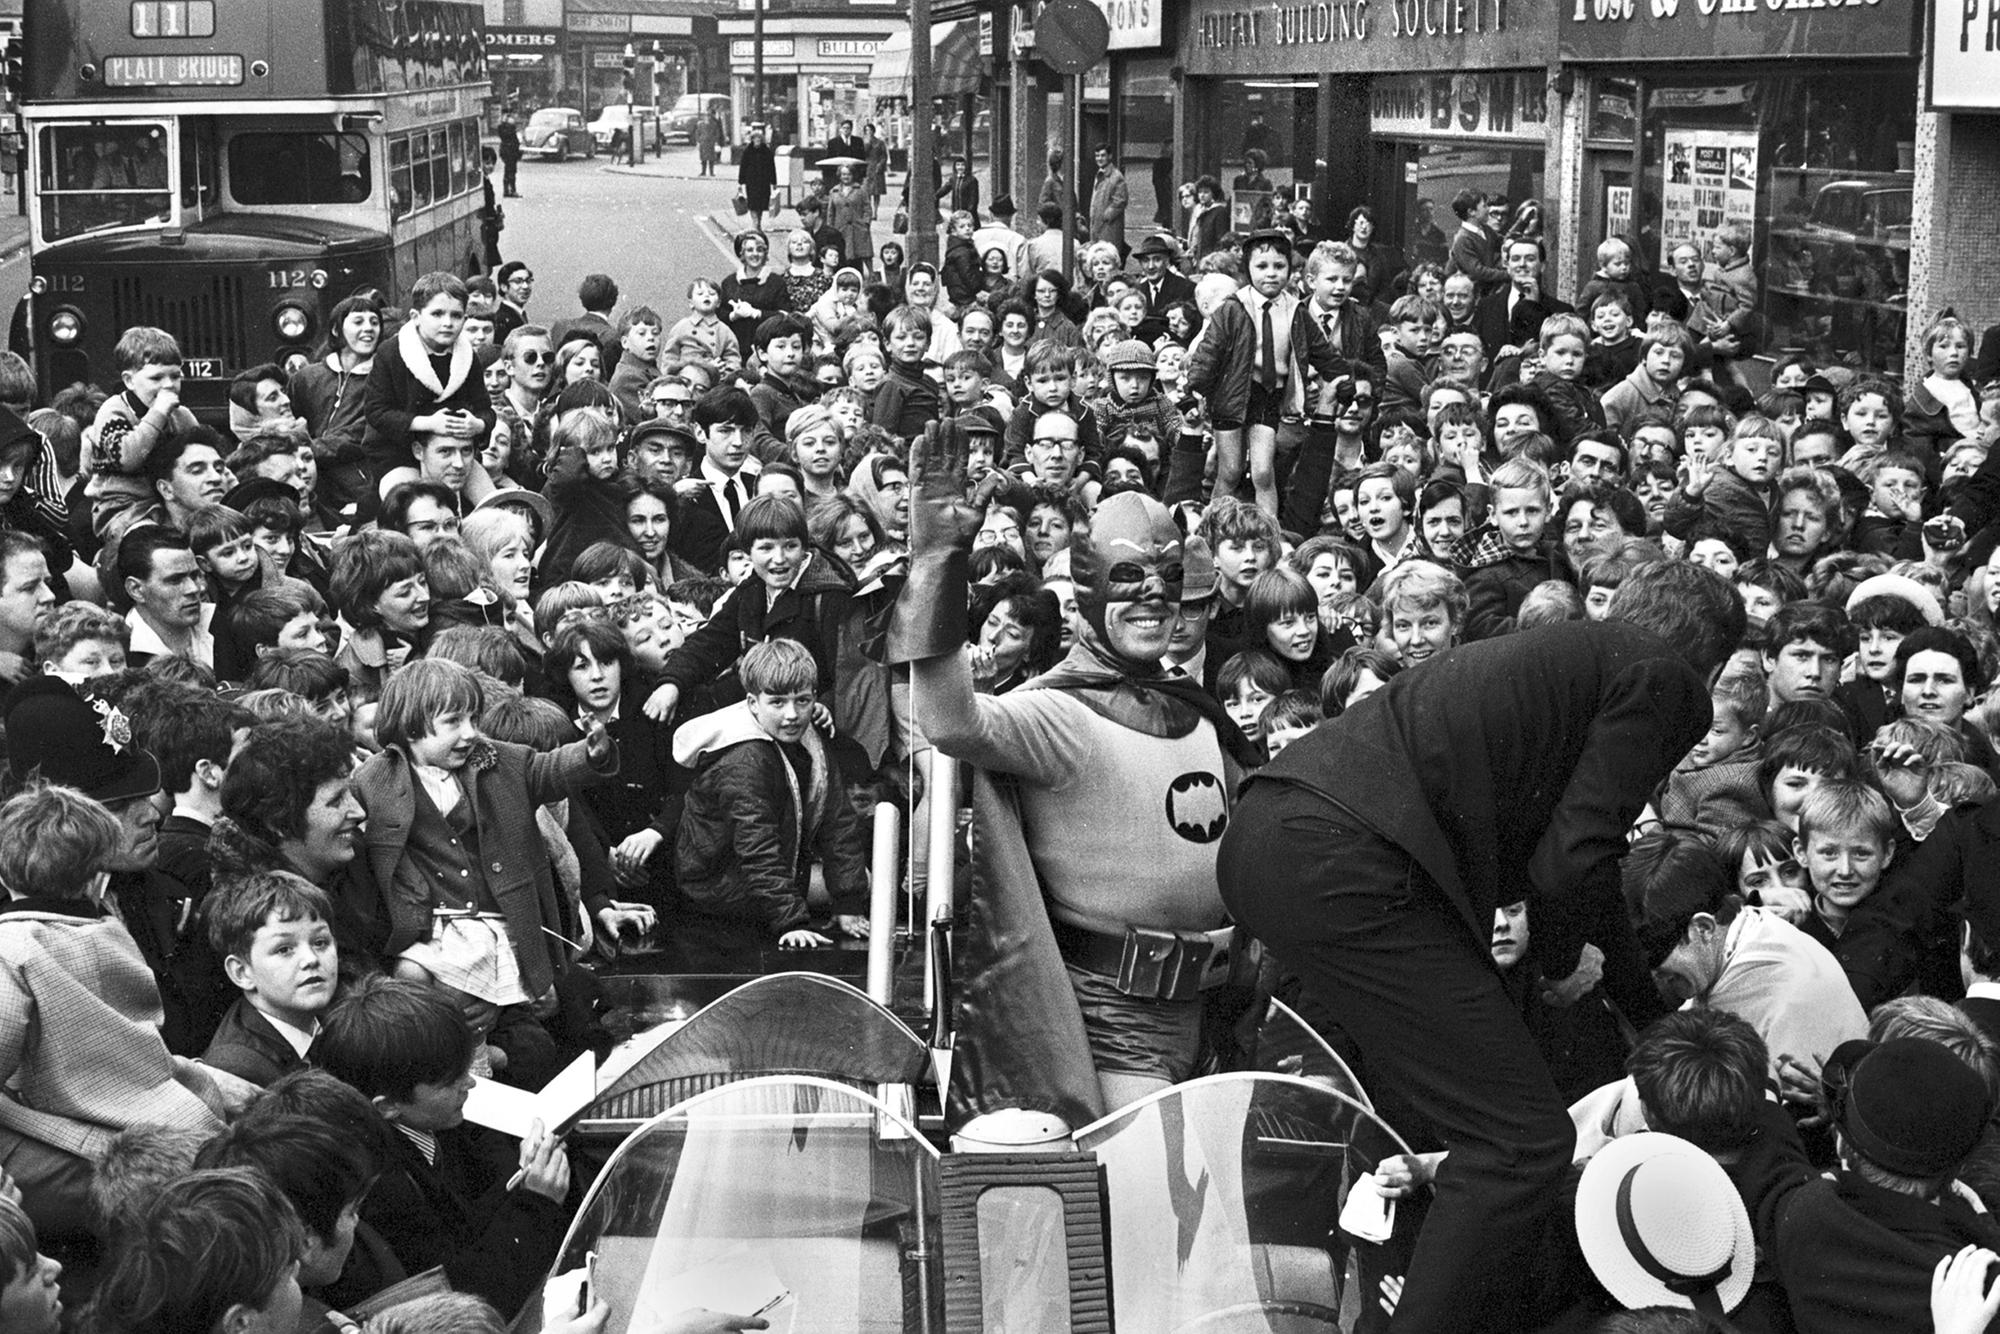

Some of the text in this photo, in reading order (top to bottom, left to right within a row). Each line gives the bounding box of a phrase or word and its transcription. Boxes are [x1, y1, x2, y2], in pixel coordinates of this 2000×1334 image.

[136, 3, 179, 36] 11
[1106, 0, 1150, 31] TONS
[1276, 0, 1366, 45] BUILDING
[178, 56, 239, 79] BRIDGE
[1612, 190, 1630, 215] GET
[52, 275, 85, 292] 112
[268, 270, 306, 288] 112
[189, 361, 212, 377] 112
